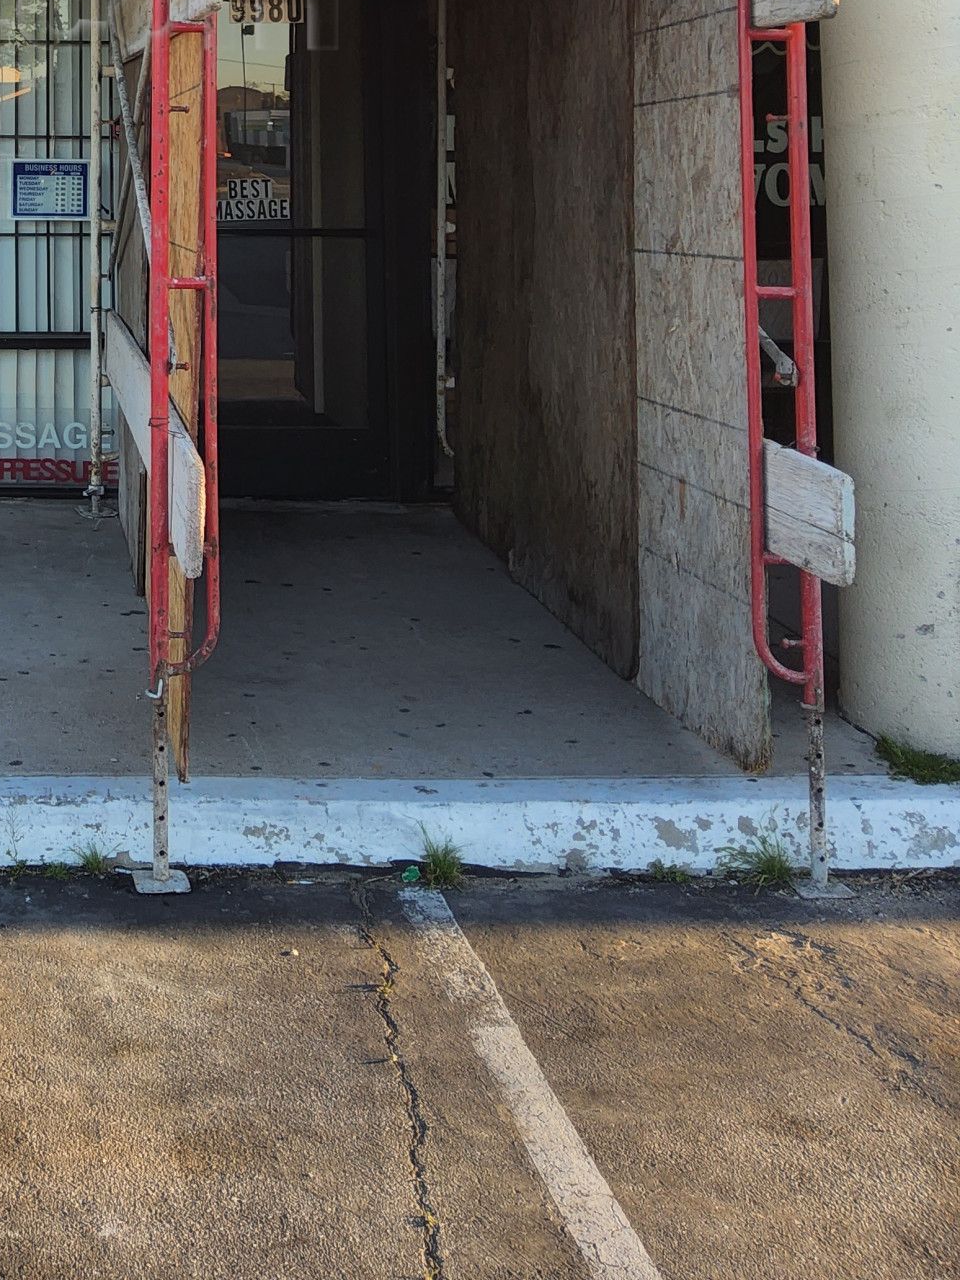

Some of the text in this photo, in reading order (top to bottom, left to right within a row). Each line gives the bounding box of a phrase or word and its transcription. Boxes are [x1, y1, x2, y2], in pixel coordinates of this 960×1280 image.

[24, 164, 83, 172] BUSINESS HOURS
[228, 179, 271, 199] BEST
